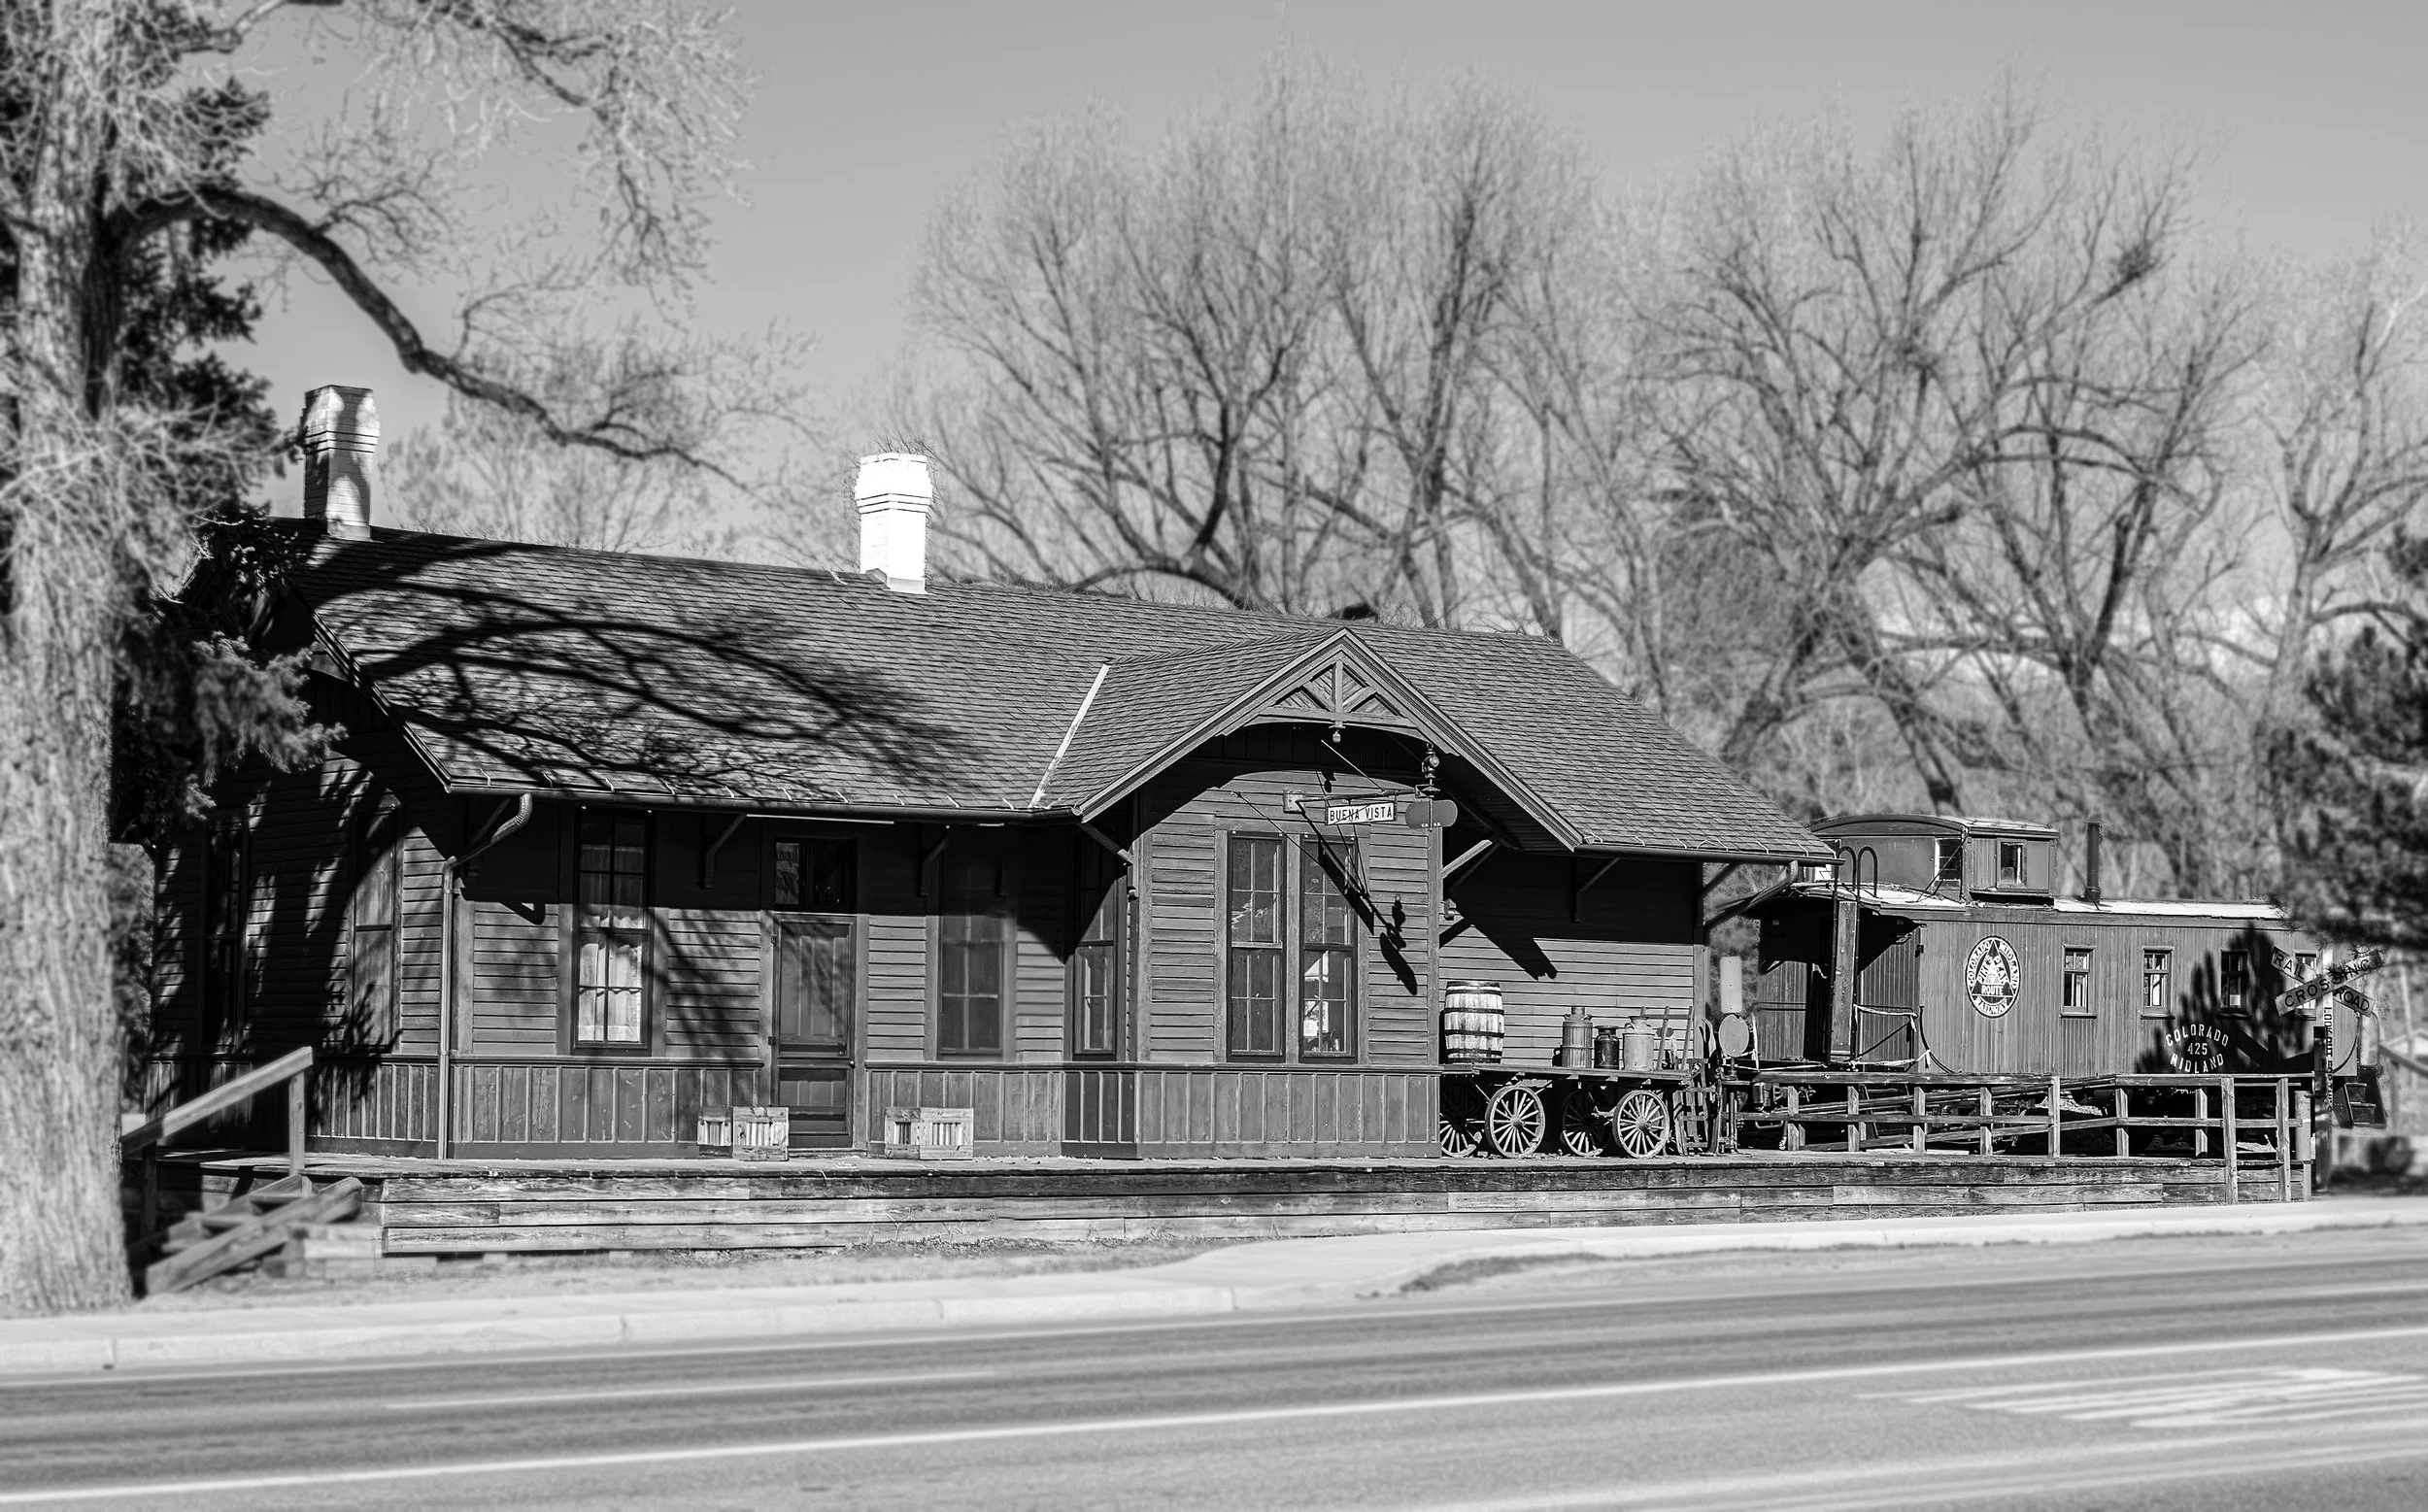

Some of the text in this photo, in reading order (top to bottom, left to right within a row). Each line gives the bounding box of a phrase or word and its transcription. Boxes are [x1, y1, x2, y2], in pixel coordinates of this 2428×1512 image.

[1330, 806, 1393, 822] BUENA VISTA
[1981, 985, 2004, 995] ROUTE
[2274, 953, 2370, 1011] RAIL ROAD
[1973, 996, 2007, 1014] RAILWAY
[2166, 1024, 2229, 1047] COLORADO
[2187, 1042, 2208, 1056] 425
[2170, 1053, 2224, 1074] MIDLAND
